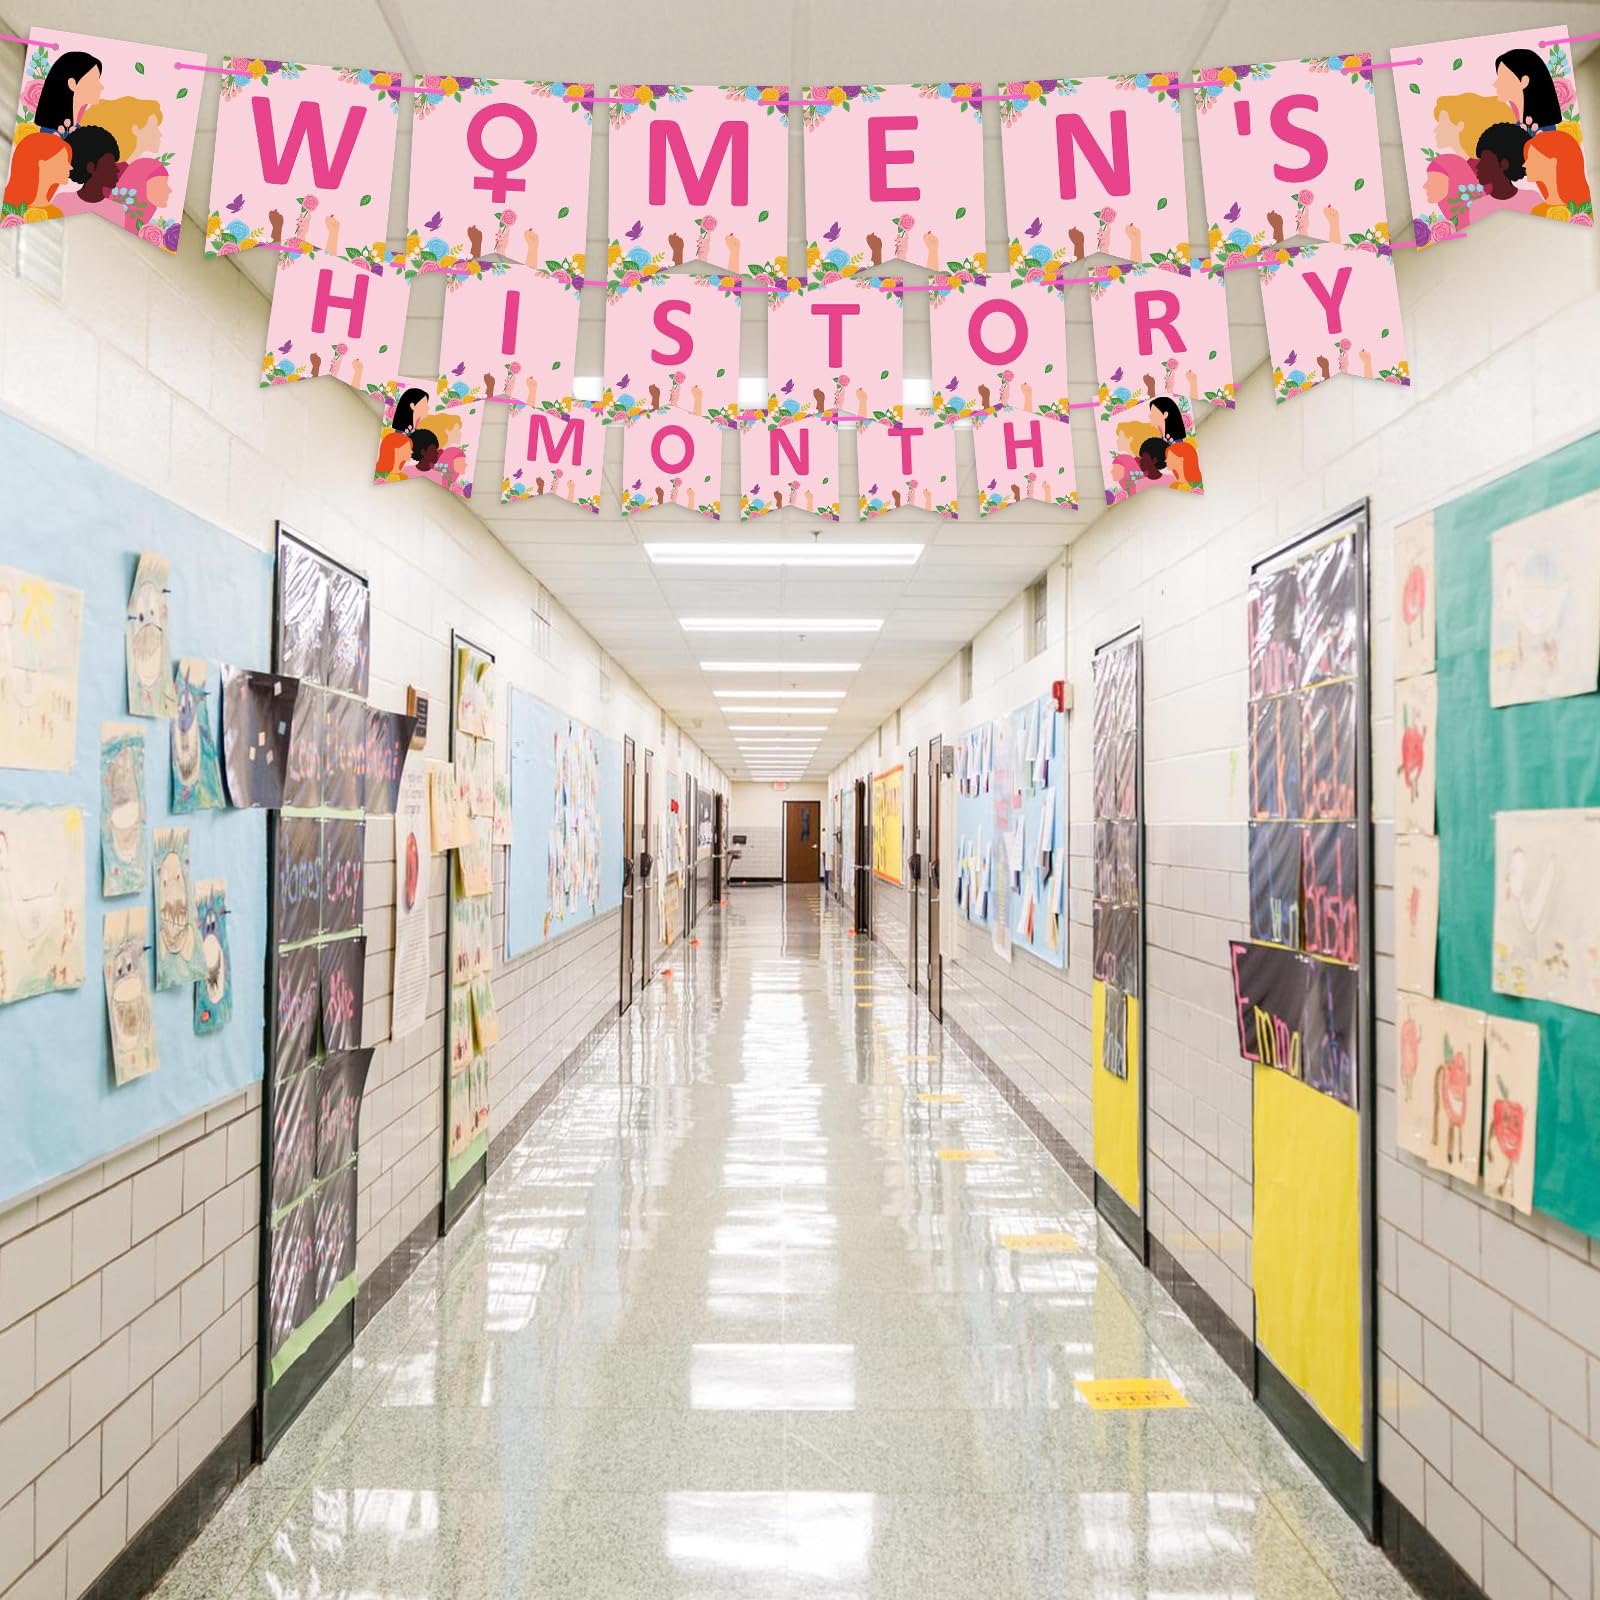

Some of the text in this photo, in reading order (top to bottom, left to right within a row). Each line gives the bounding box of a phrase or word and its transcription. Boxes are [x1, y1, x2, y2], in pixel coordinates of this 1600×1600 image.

[311, 267, 1352, 366] HISTORY
[527, 414, 1043, 476] MONTH
[1231, 943, 1301, 1077] Emma
